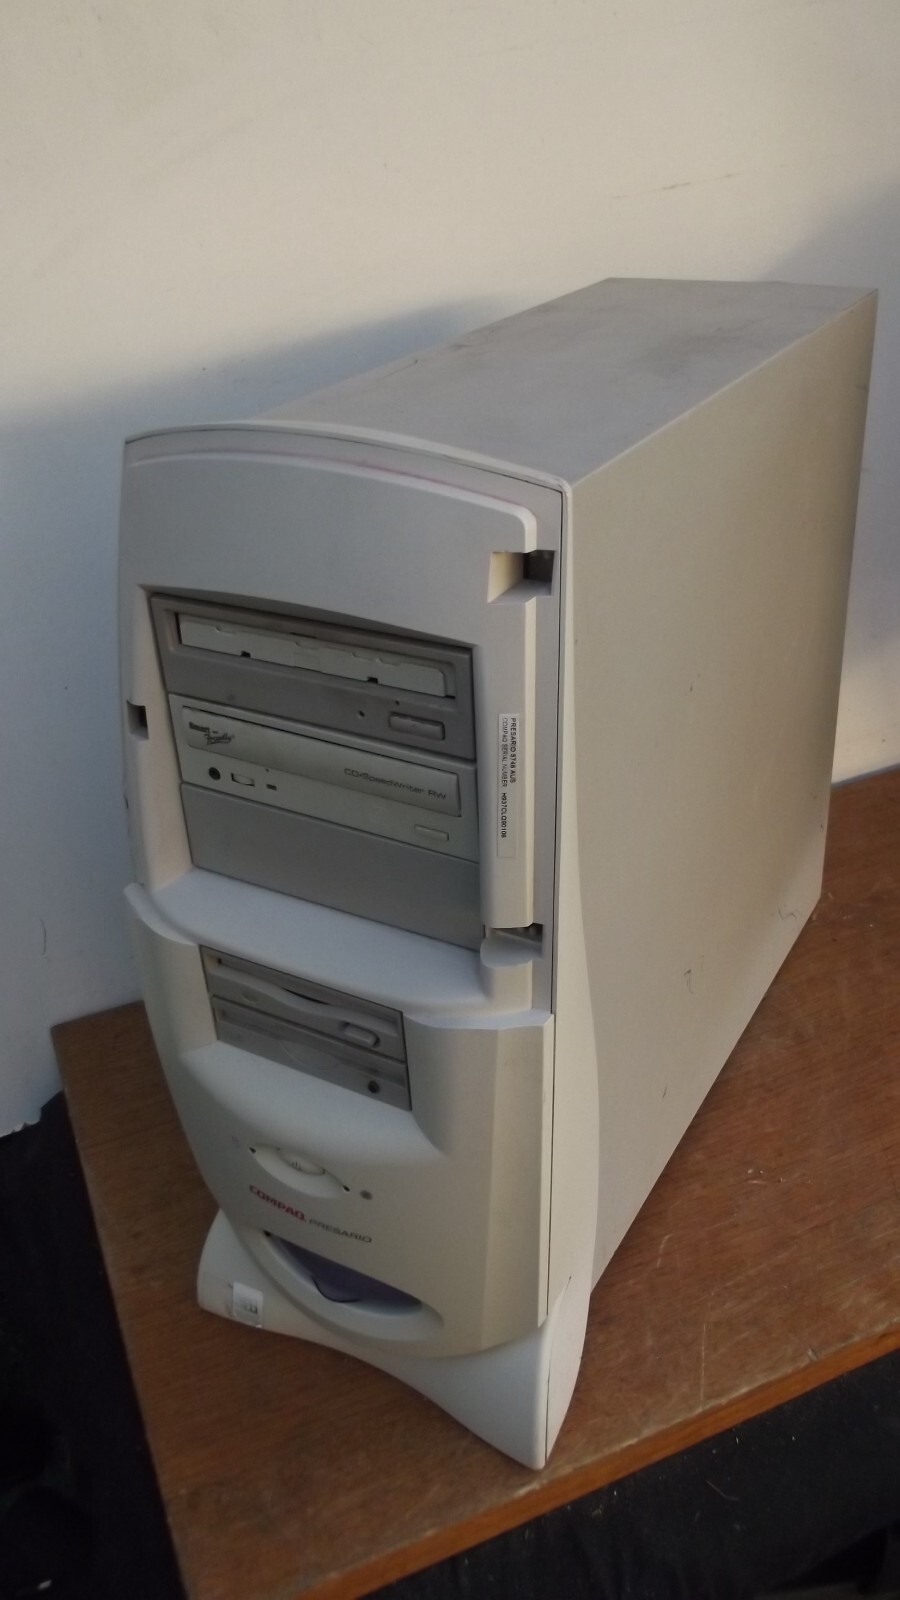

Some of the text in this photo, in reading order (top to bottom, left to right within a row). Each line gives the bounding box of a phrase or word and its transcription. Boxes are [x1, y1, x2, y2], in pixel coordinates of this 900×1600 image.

[509, 769, 517, 784] AUS
[428, 789, 447, 800] RW
[249, 1185, 373, 1243] COMPAQ PRESARIO
